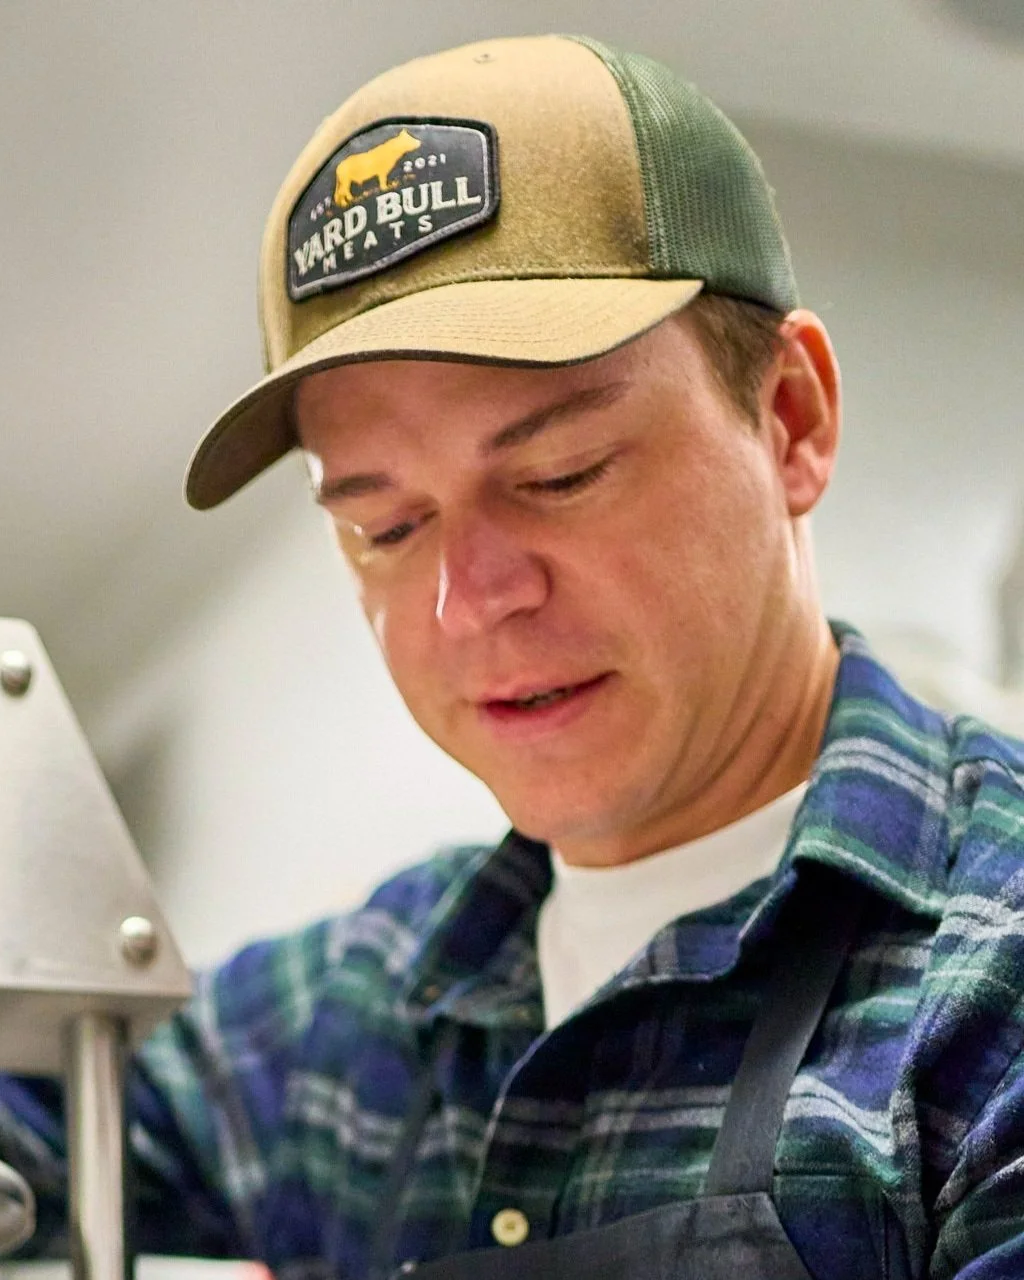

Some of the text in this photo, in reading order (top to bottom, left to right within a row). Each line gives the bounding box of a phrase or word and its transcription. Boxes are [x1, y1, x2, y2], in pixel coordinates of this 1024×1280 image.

[403, 153, 446, 172] 2021
[293, 176, 482, 277] YARD BULL
[323, 215, 432, 274] MEATS
